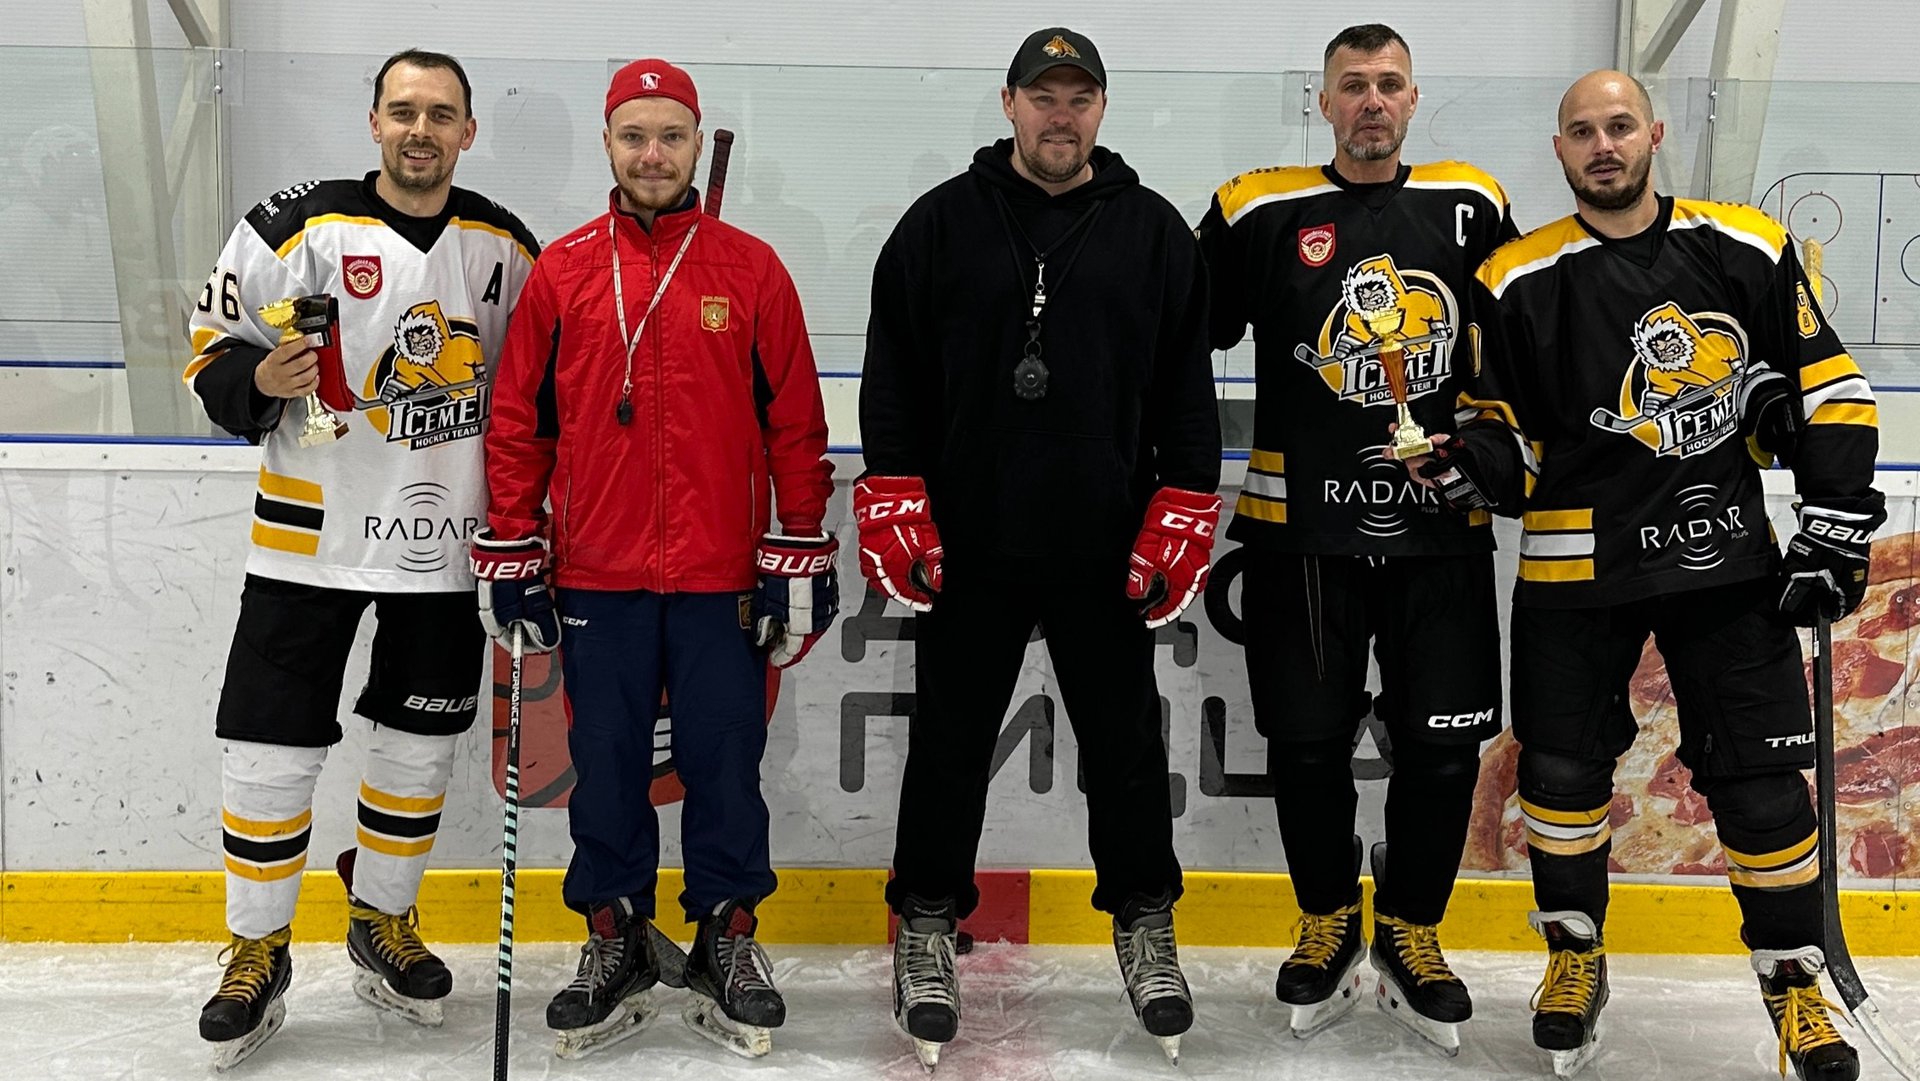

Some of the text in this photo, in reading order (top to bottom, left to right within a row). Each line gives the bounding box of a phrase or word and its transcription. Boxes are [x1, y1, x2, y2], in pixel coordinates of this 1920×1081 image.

[1455, 203, 1475, 247] C
[480, 261, 504, 306] A
[415, 425, 479, 449] HOCKEY TEAM
[1324, 479, 1440, 505] RADAR
[855, 499, 926, 523] CCM
[364, 516, 479, 540] RADAR
[1160, 511, 1215, 538] CC
[1640, 506, 1744, 549] RADAR
[562, 615, 589, 627] CCM
[1427, 707, 1495, 729] CCM
